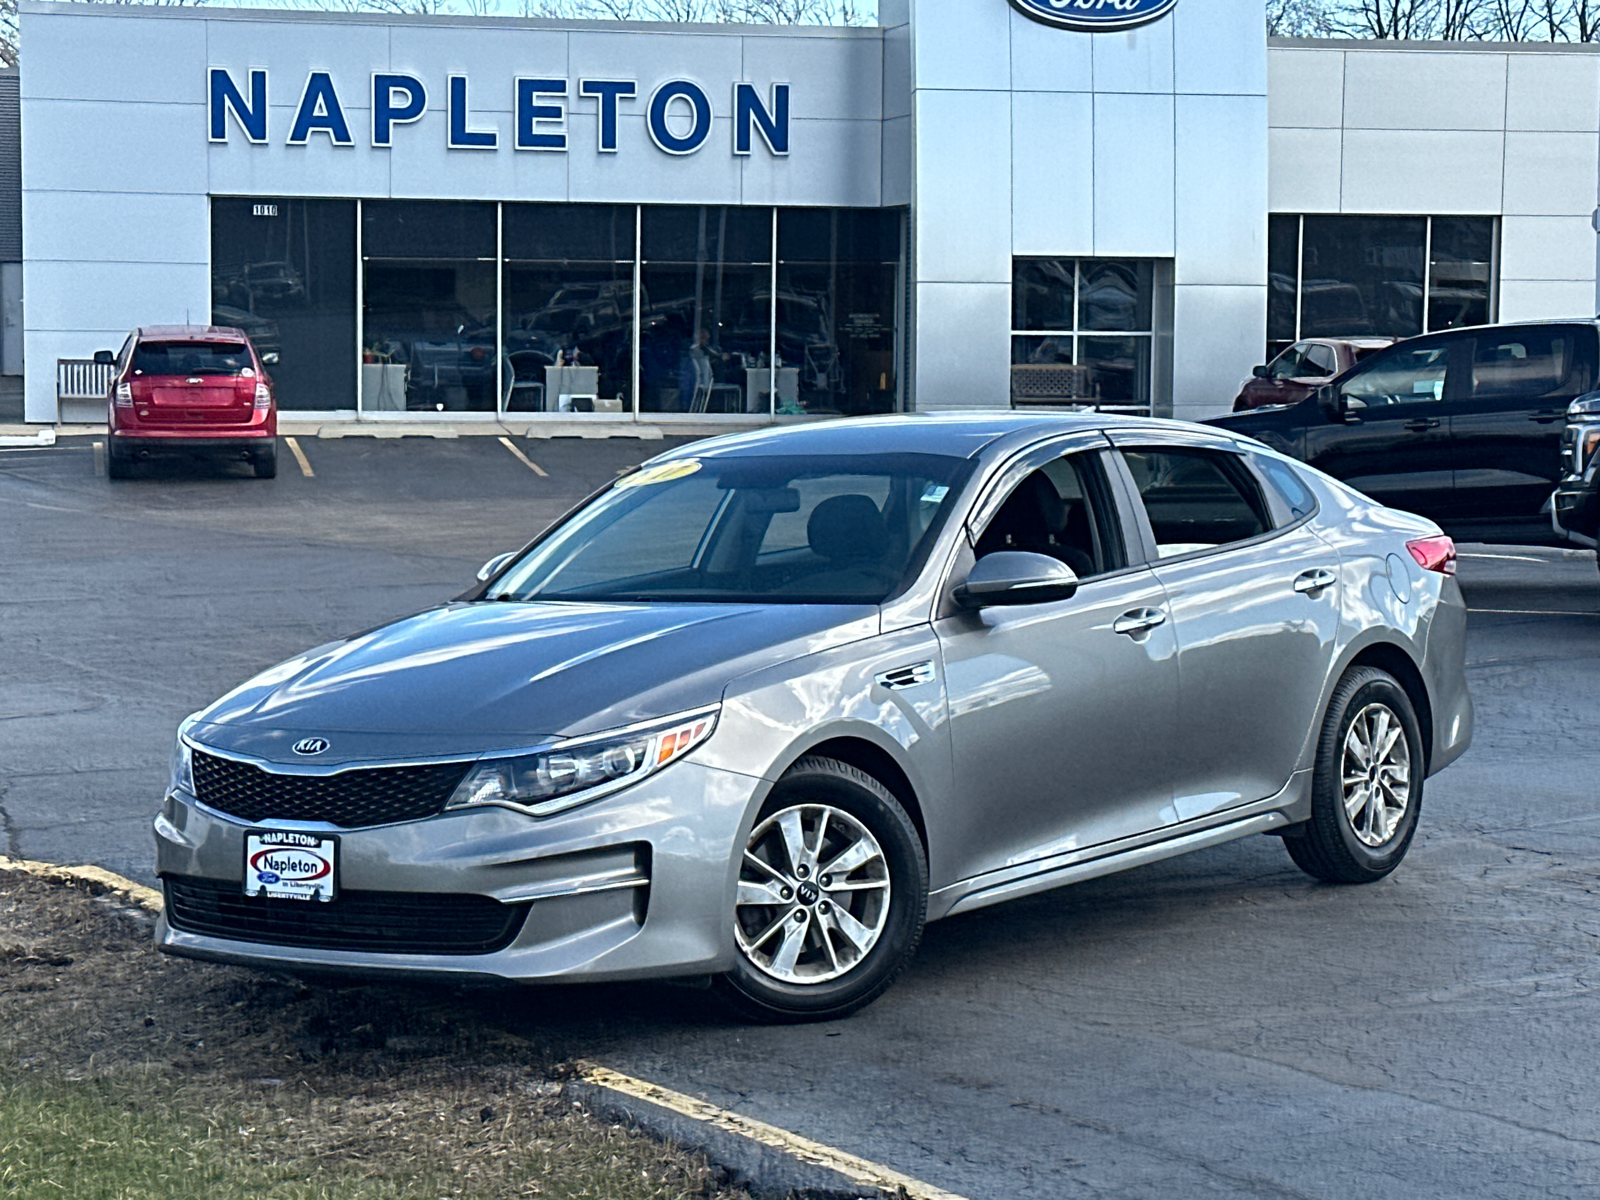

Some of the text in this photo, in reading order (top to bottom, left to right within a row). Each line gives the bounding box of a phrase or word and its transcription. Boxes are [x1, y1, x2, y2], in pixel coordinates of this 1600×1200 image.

[207, 68, 791, 157] NAPLETON
[253, 204, 278, 216] 1010
[297, 739, 323, 751] KIA
[263, 832, 315, 846] NAPLETON
[263, 854, 318, 875] Napleton
[800, 885, 817, 901] KIA
